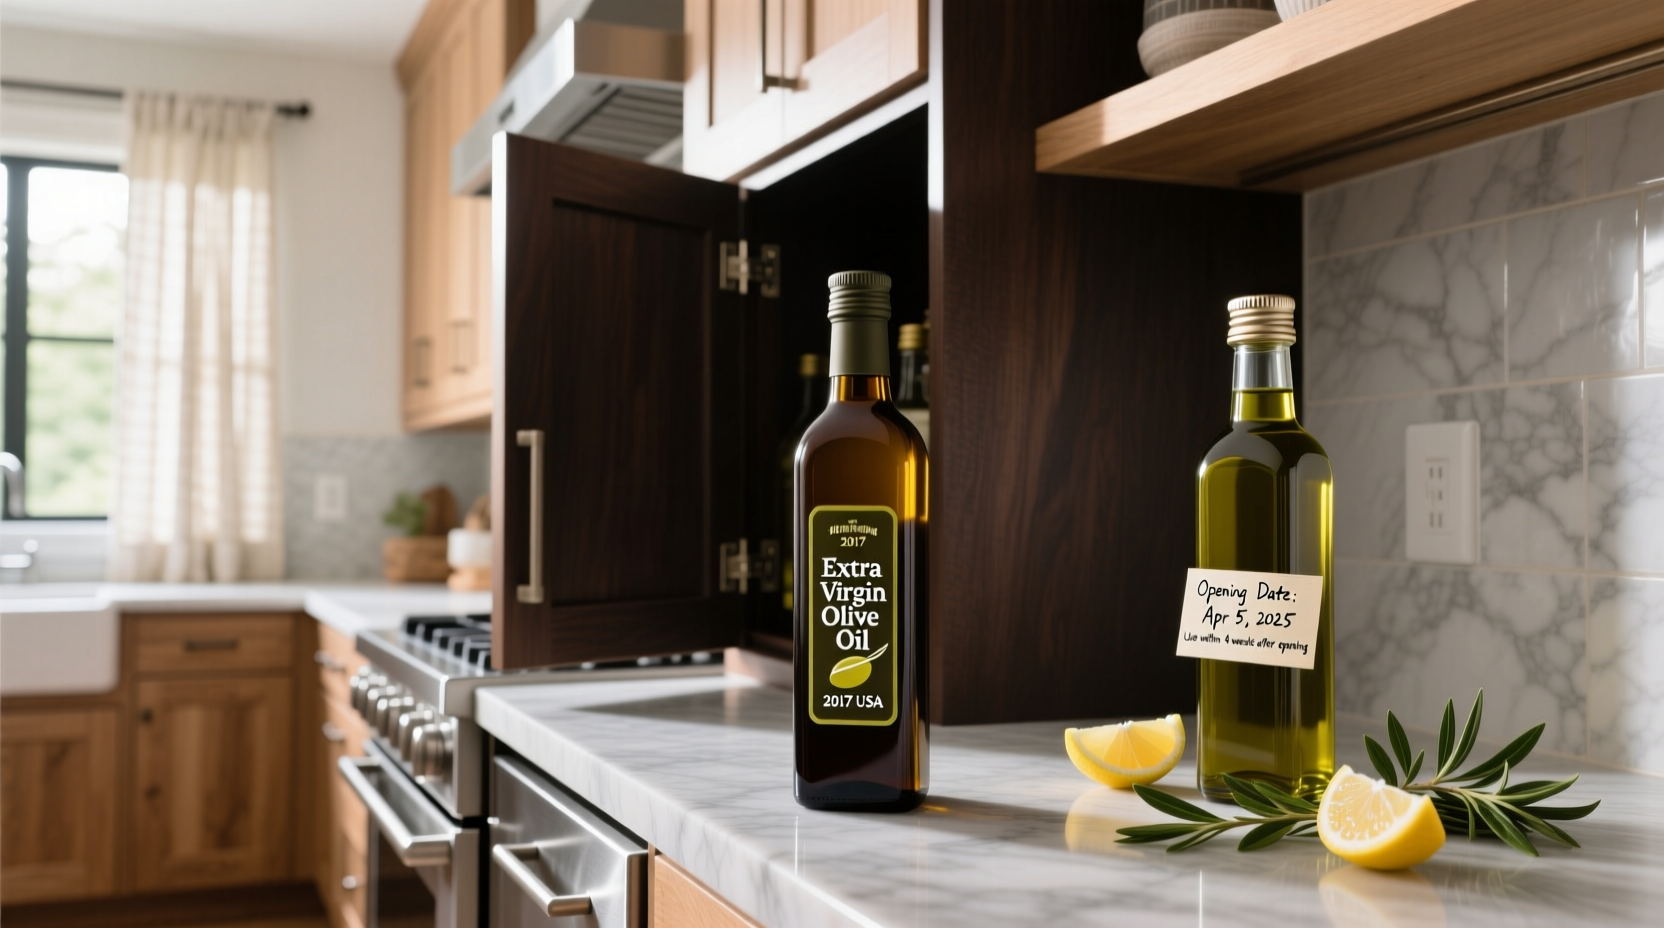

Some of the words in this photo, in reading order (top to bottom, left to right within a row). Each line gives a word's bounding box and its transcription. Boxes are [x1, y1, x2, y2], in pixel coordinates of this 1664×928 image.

[840, 536, 867, 547] 2017
[821, 557, 883, 578] Extra
[820, 581, 887, 607] Virgin
[1197, 579, 1247, 606] Opening
[1257, 581, 1297, 602] Date:
[821, 605, 879, 626] Olive
[1202, 605, 1229, 630] Apr
[1235, 609, 1248, 628] 5,
[1256, 611, 1297, 628] 2025
[836, 628, 870, 650] Oil
[1225, 634, 1230, 644] 4
[823, 694, 853, 708] 2017
[856, 694, 884, 708] USA
